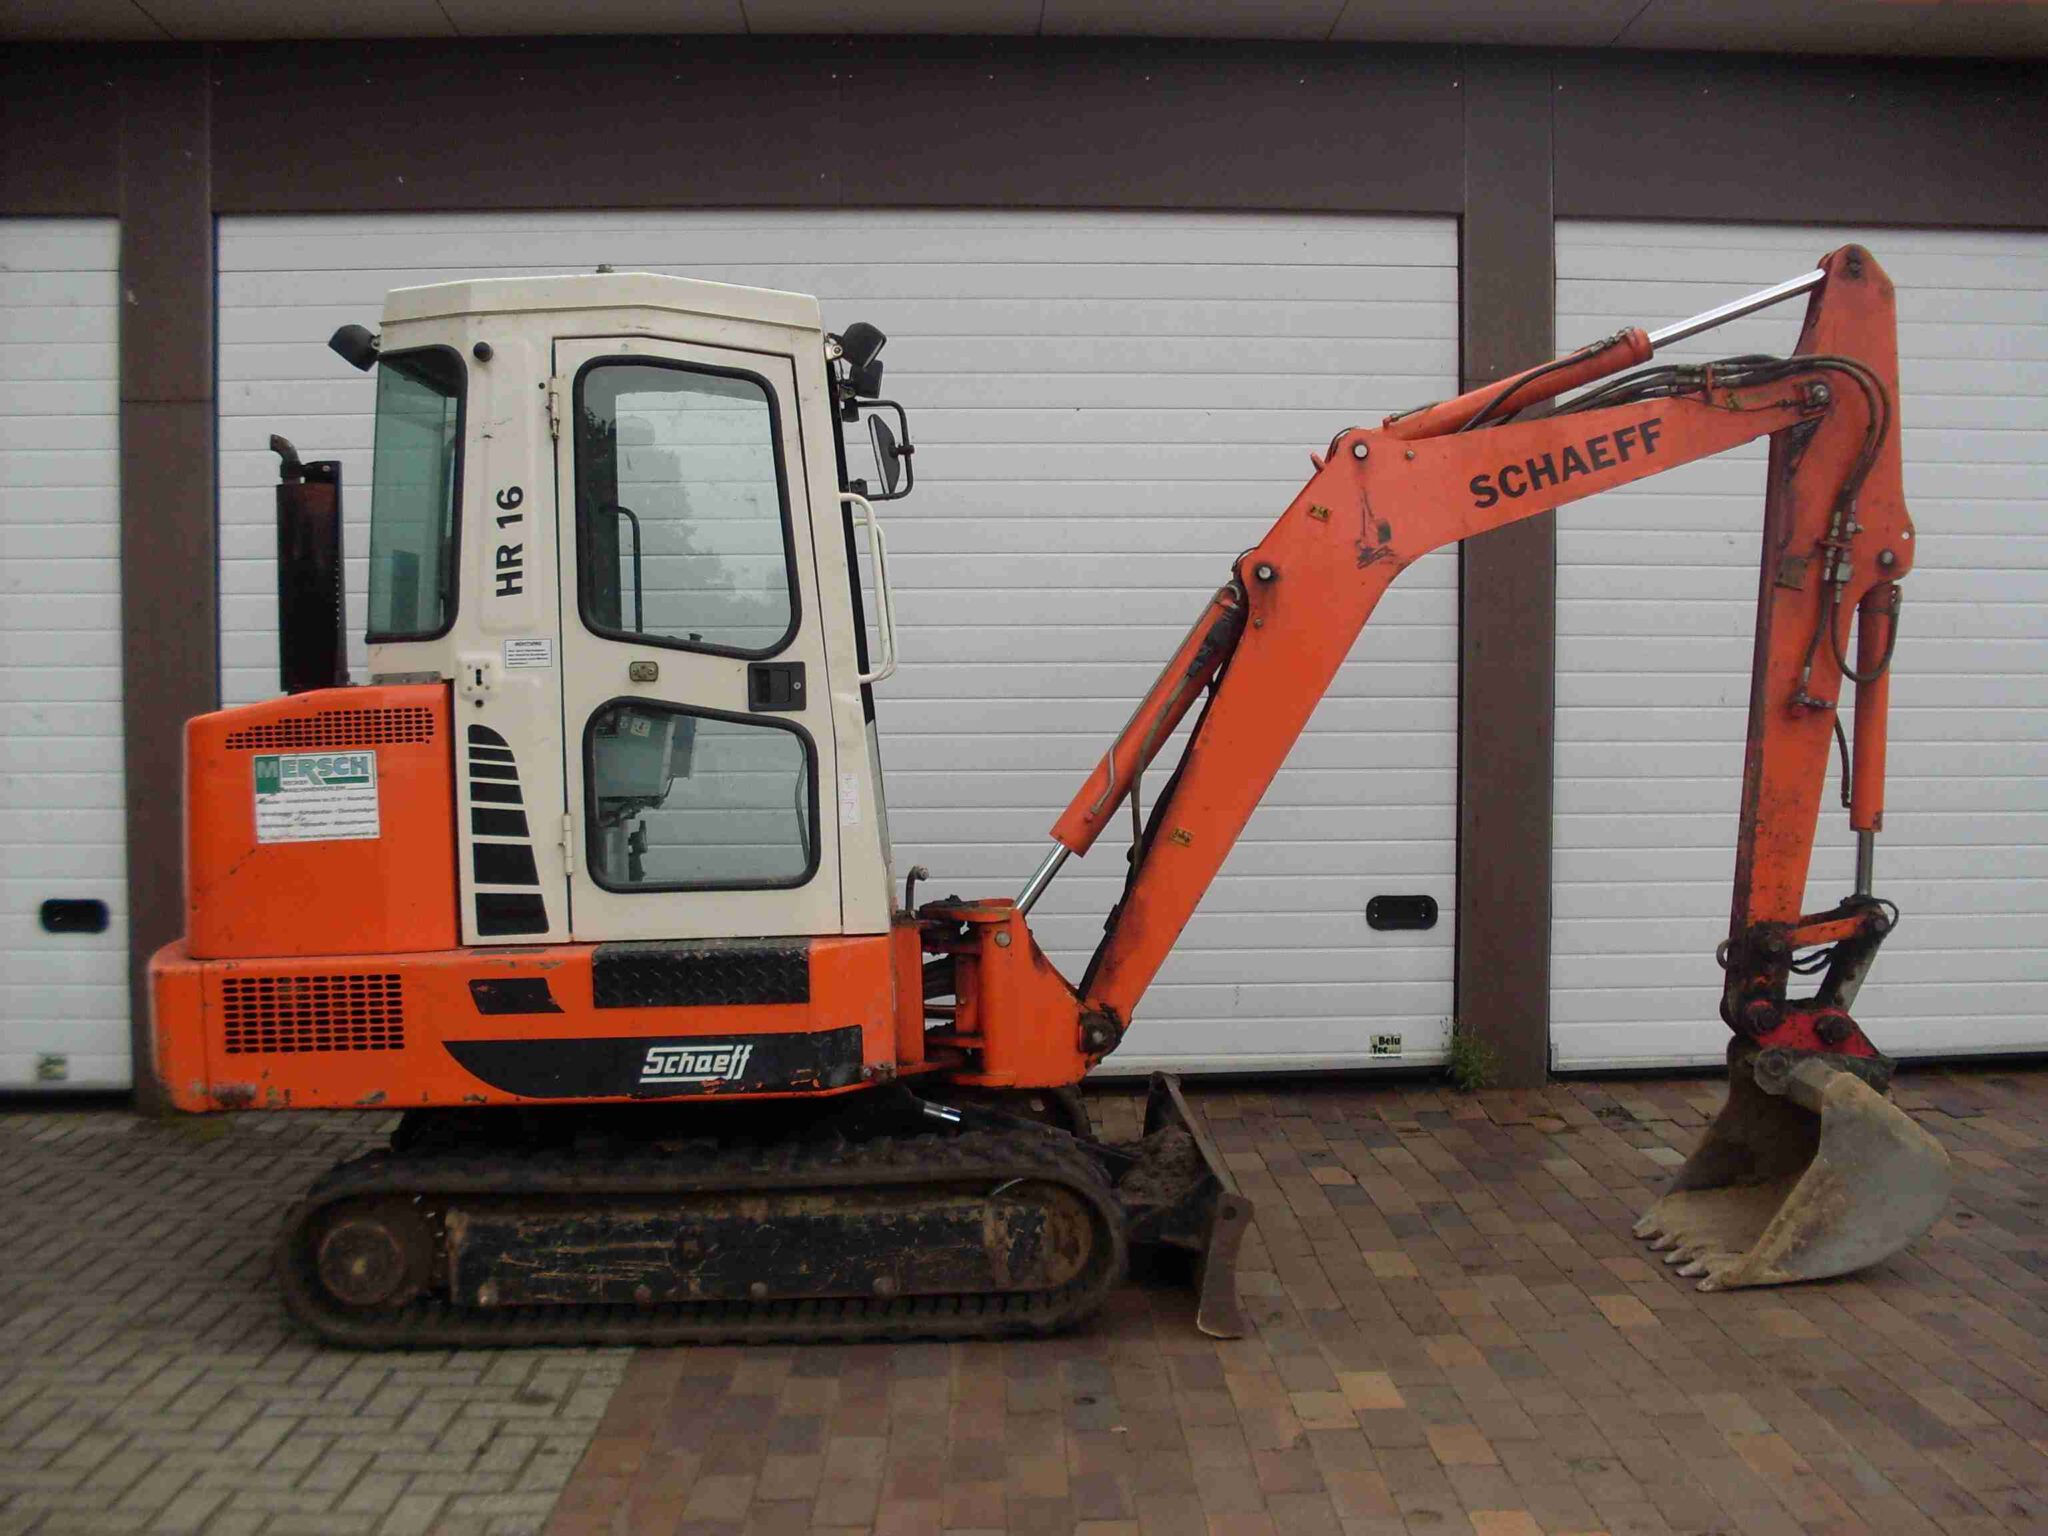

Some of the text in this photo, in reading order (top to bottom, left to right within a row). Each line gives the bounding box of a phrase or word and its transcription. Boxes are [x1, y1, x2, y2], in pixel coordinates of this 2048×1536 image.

[1469, 418, 1662, 508] SCHAEFF
[496, 486, 524, 597] HR 16
[256, 756, 369, 785] MERSCH
[640, 1044, 753, 1083] Schaeff
